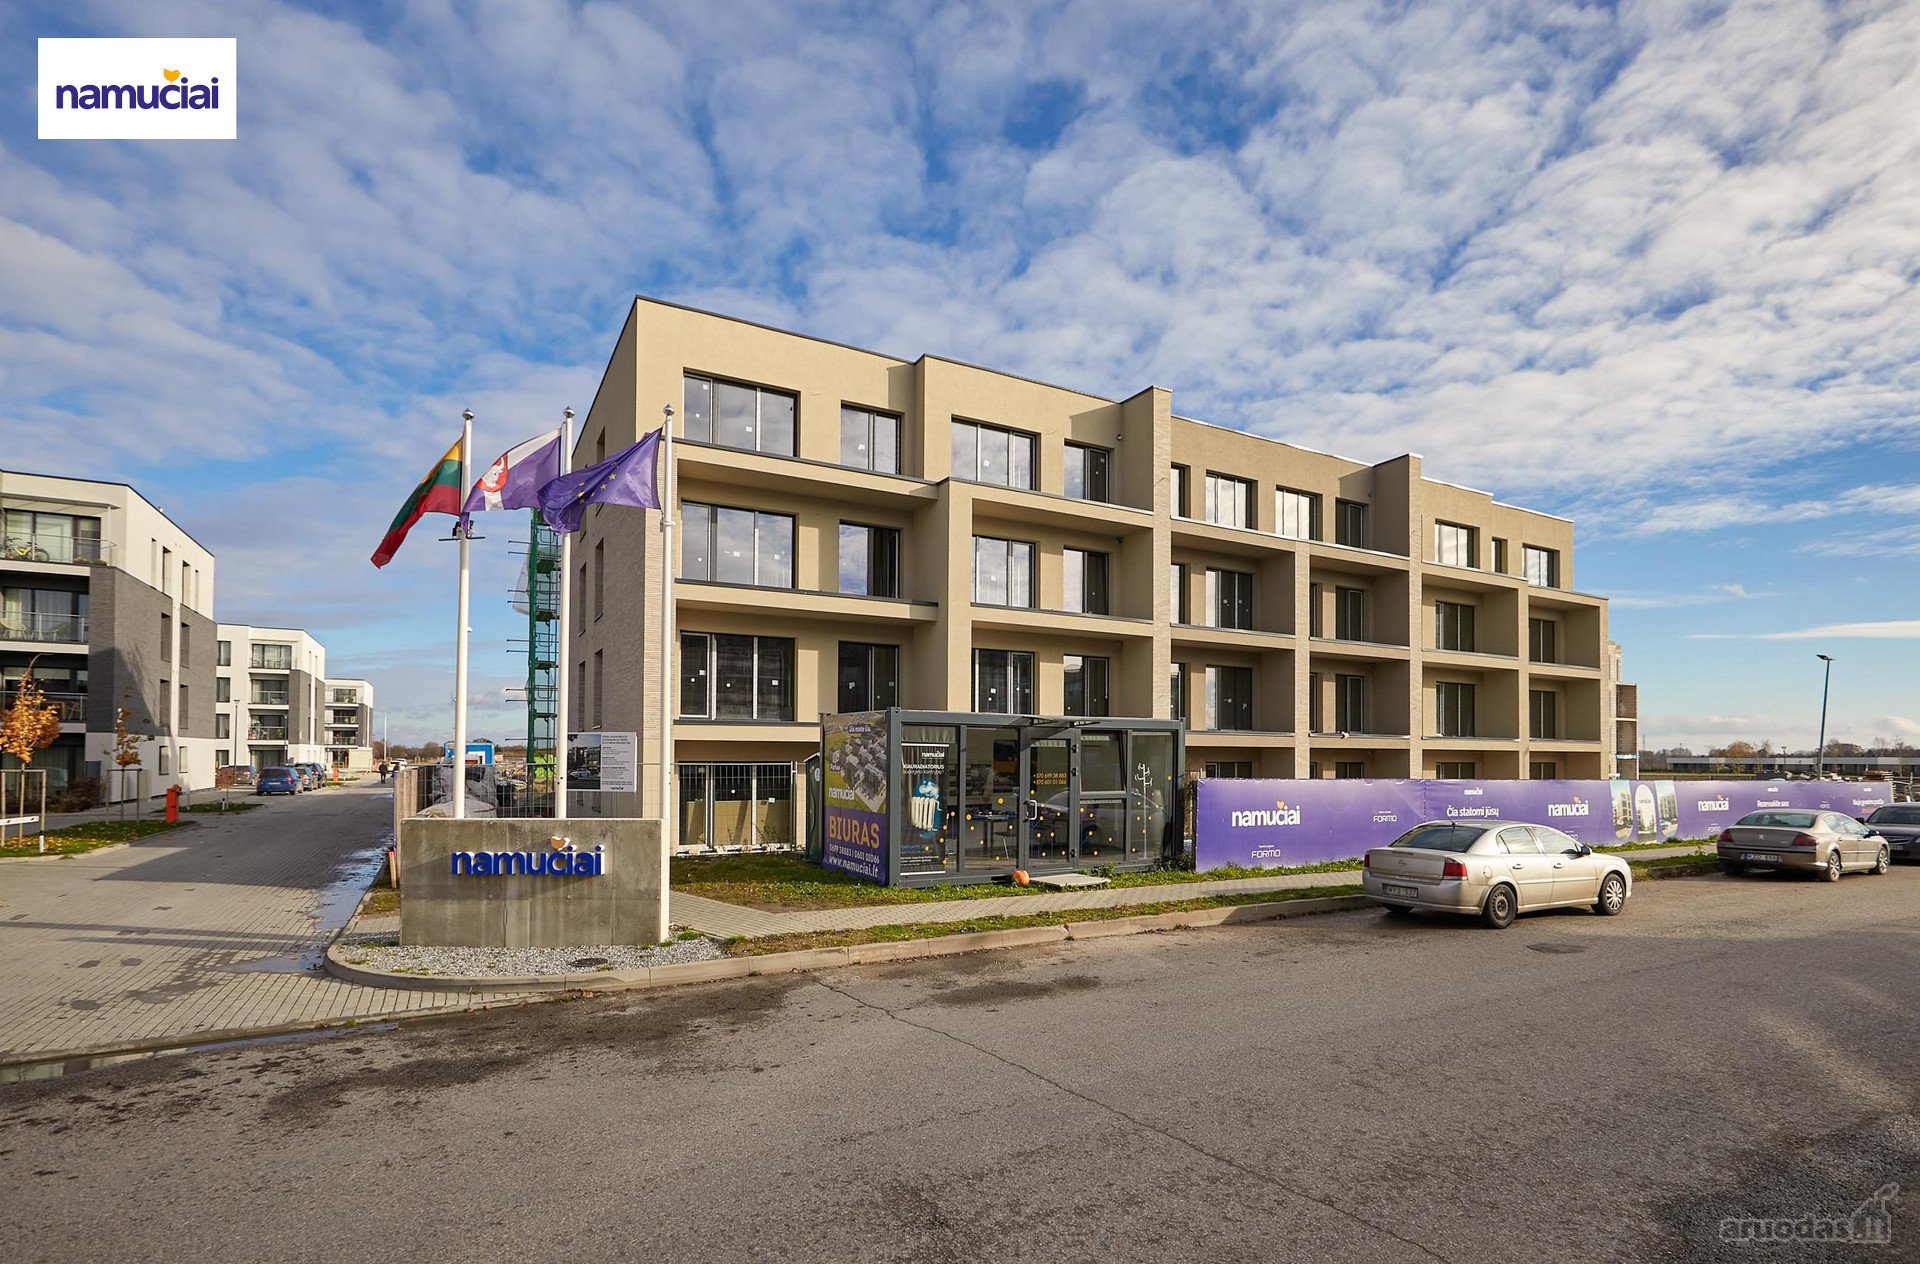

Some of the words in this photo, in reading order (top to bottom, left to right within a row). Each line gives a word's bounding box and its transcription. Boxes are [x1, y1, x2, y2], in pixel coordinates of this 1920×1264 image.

[1446, 804, 1459, 817] Čia
[1459, 806, 1484, 817] statomi
[1484, 806, 1500, 818] jūsų
[829, 815, 880, 849] BIURAS
[1251, 849, 1281, 859] FORMO
[828, 855, 879, 878] www.namuciai.lt
